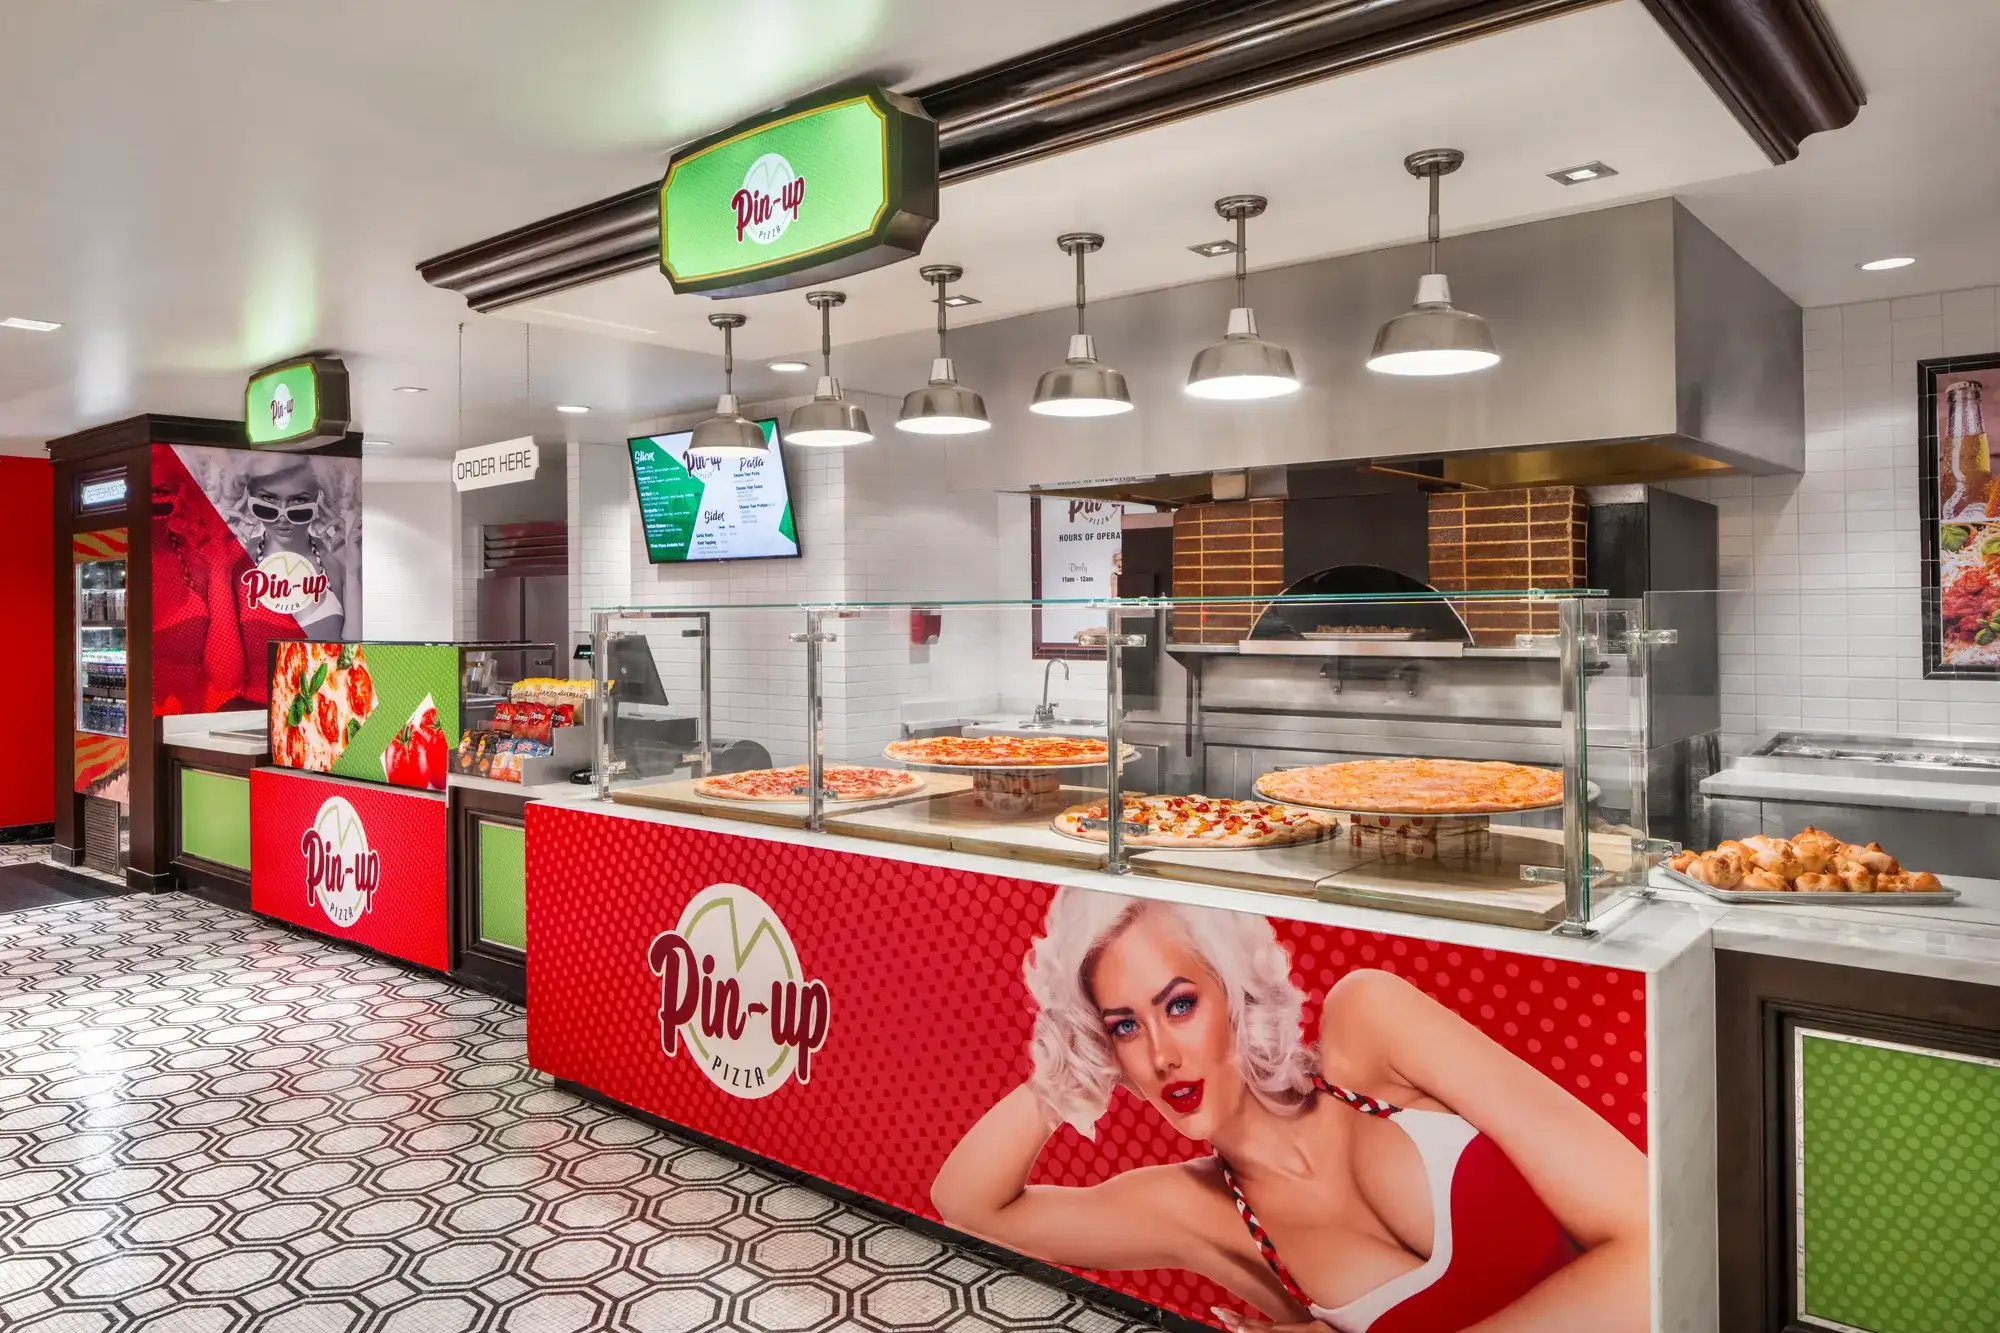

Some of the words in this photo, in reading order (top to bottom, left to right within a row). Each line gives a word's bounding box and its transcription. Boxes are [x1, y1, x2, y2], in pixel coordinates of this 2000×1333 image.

[731, 176, 805, 242] Pin-up
[758, 225, 781, 240] PIZZA
[270, 398, 294, 427] Pin-up
[457, 457, 496, 480] ORDER
[499, 449, 532, 473] HERE
[739, 456, 766, 472] Pasta
[1088, 516, 1109, 525] PIZZA
[1059, 533, 1082, 542] HOURS
[1085, 532, 1094, 541] OF
[1096, 531, 1122, 541] OPERA
[1069, 562, 1088, 574] Daily
[242, 568, 328, 609] Pin-up
[274, 602, 301, 612] PIZZA
[302, 829, 379, 913] Pin-up
[330, 902, 354, 921] PIZZA
[649, 932, 828, 1081] Pin-up
[711, 1054, 766, 1089] PIZZA
